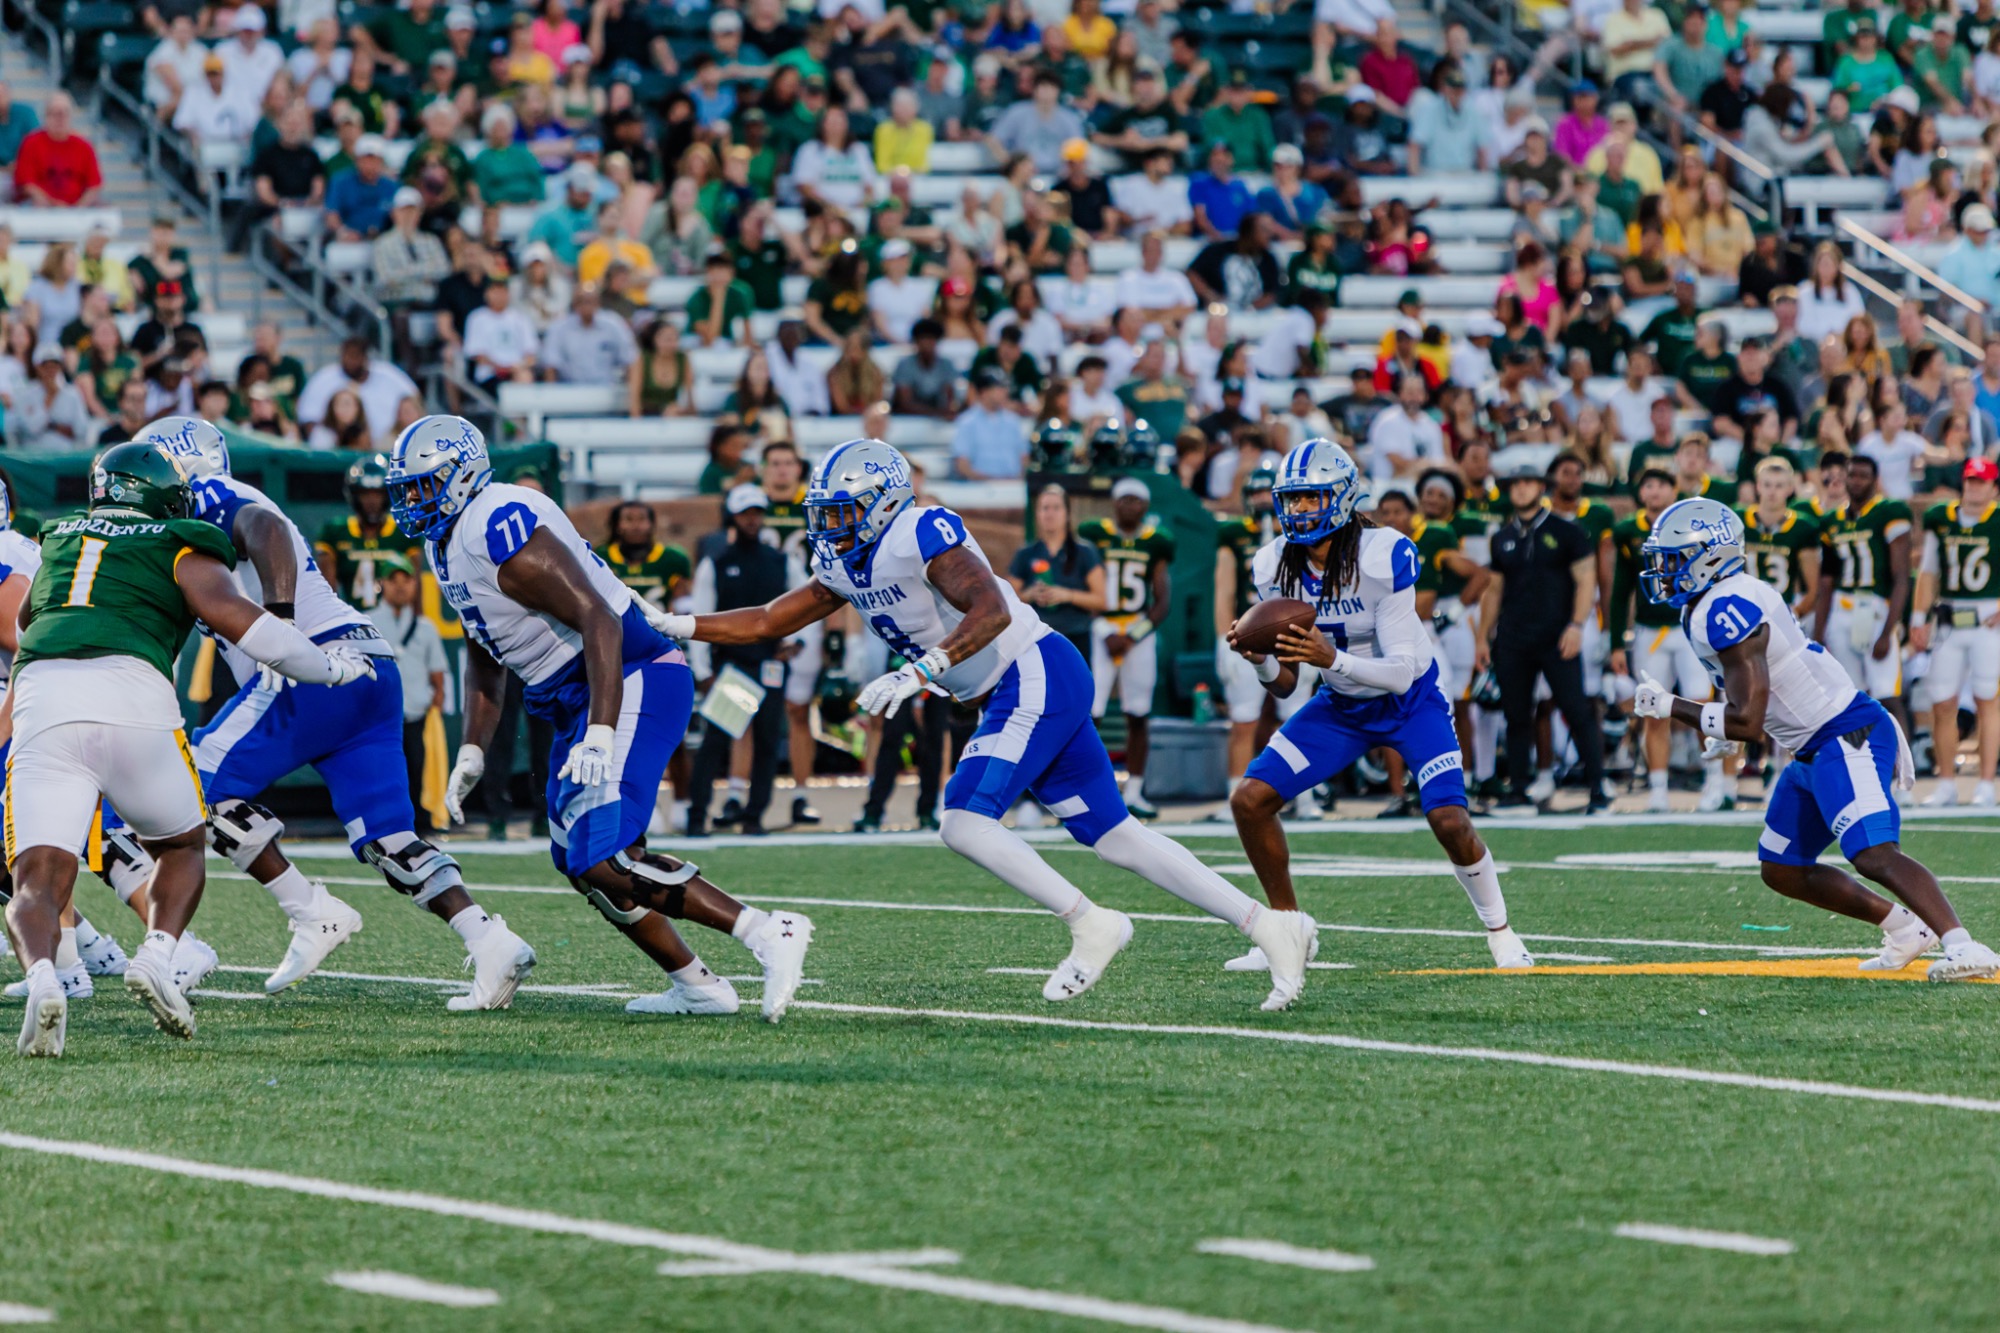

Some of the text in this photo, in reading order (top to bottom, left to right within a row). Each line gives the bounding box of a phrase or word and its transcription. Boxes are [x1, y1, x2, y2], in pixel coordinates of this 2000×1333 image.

[495, 510, 529, 553] 77
[933, 517, 959, 546] 8
[61, 535, 109, 608] 1
[1404, 546, 1417, 577] 7
[1836, 540, 1876, 588] 11
[1945, 543, 1991, 592] 16
[1105, 560, 1148, 612] 15
[871, 613, 926, 663] 8
[1315, 622, 1349, 653] 7
[1714, 603, 1750, 640] 31
[1421, 756, 1456, 780] PIRATES
